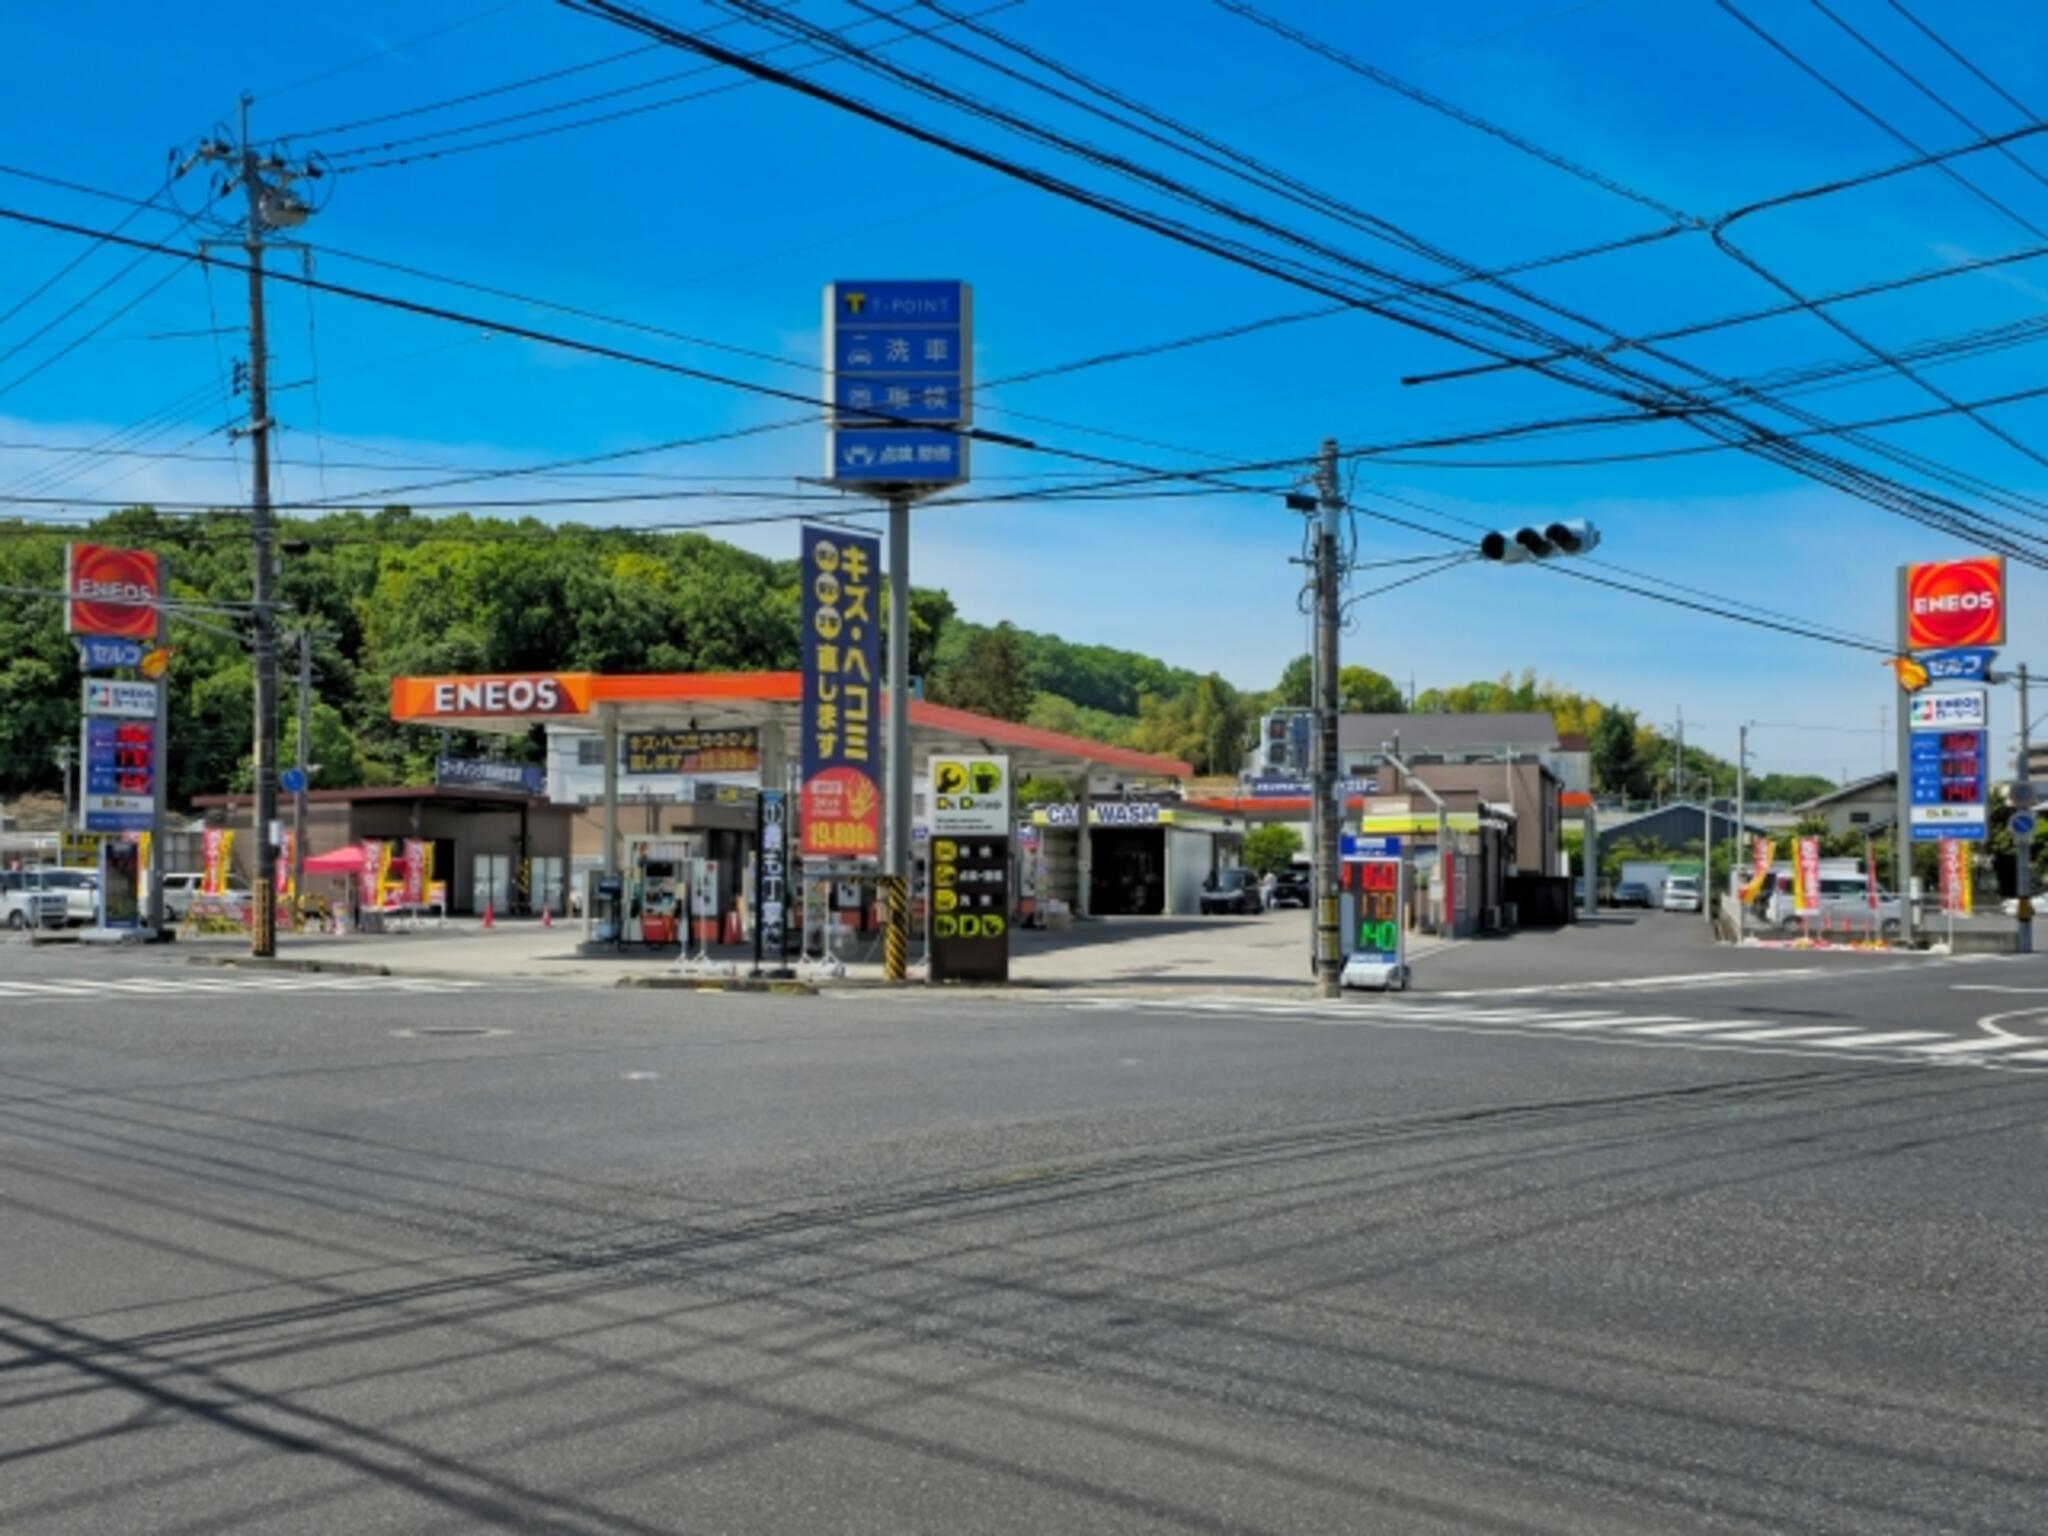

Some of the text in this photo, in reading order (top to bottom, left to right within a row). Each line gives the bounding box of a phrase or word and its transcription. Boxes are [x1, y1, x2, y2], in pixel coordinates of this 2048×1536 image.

[885, 338, 948, 363] 洗車
[79, 579, 152, 602] ENEOS
[1912, 592, 1994, 615] ENEOS
[842, 545, 871, 761] キズ・ヘコミ
[434, 678, 559, 713] ENEOS
[1047, 802, 1160, 824] CA WASH
